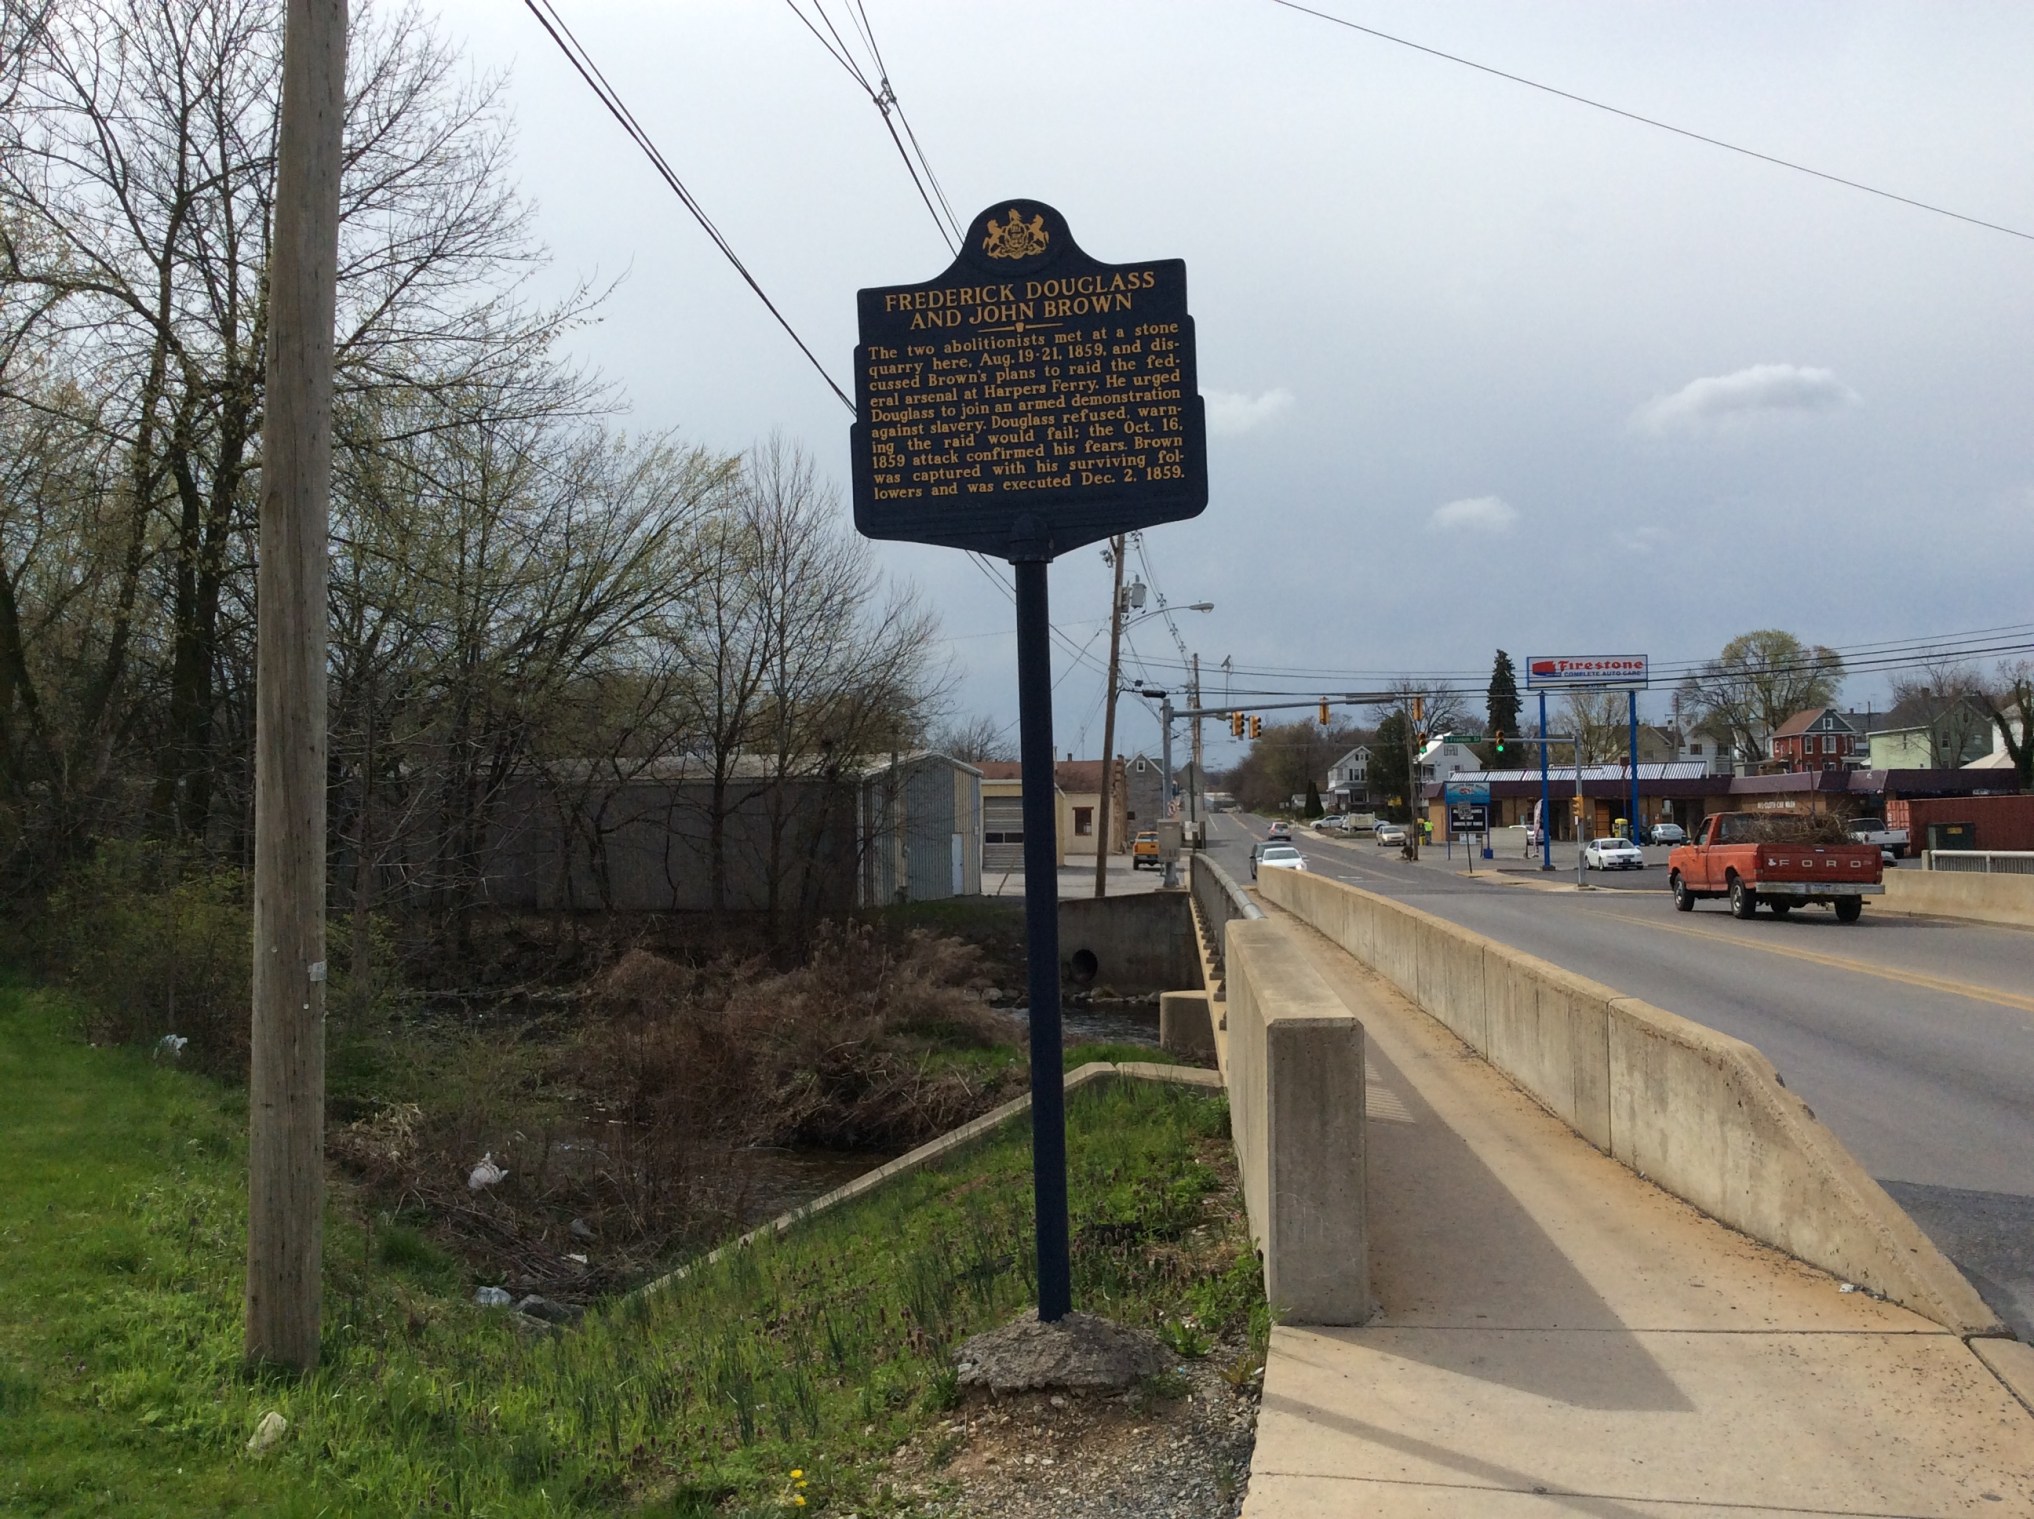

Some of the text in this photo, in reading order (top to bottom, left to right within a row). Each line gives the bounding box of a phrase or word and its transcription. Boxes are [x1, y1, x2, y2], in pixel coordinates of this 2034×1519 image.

[885, 271, 1155, 312] FREDERICK DOUGLASS
[910, 293, 1132, 329] AND JOHN BROWN
[869, 323, 1178, 360] The two abolitionists met at a stone
[869, 362, 923, 380] quarry
[1113, 340, 1141, 354] and
[1151, 338, 1179, 351] dis-
[869, 354, 1180, 391] cussed Brown's plans to raid the fed-
[870, 370, 1180, 408] eral arsenal at Harpers Ferry. He urged
[871, 388, 1181, 425] Douglass to join an armed demonstration
[871, 423, 924, 442] against
[930, 421, 986, 434] slavery.
[991, 414, 1055, 431] Douglass
[1138, 406, 1182, 417] warn-
[872, 442, 894, 456] ing
[907, 438, 931, 451] the
[944, 433, 975, 448] raid
[988, 429, 1034, 444] would
[1089, 423, 1114, 436] the
[1124, 421, 1154, 434] Oct.
[872, 437, 1183, 468] 1859 attack confirmed his fears. Brown
[874, 450, 1184, 484] was captured with his surviving fol-
[874, 487, 922, 500] lowers
[931, 482, 958, 496] and
[968, 482, 994, 493] was
[1003, 474, 1071, 491] executed
[1081, 472, 1115, 485] Dec.
[1146, 466, 1185, 480] 1859.
[1558, 660, 1644, 672] Firestone
[1779, 859, 1862, 868] FORD
